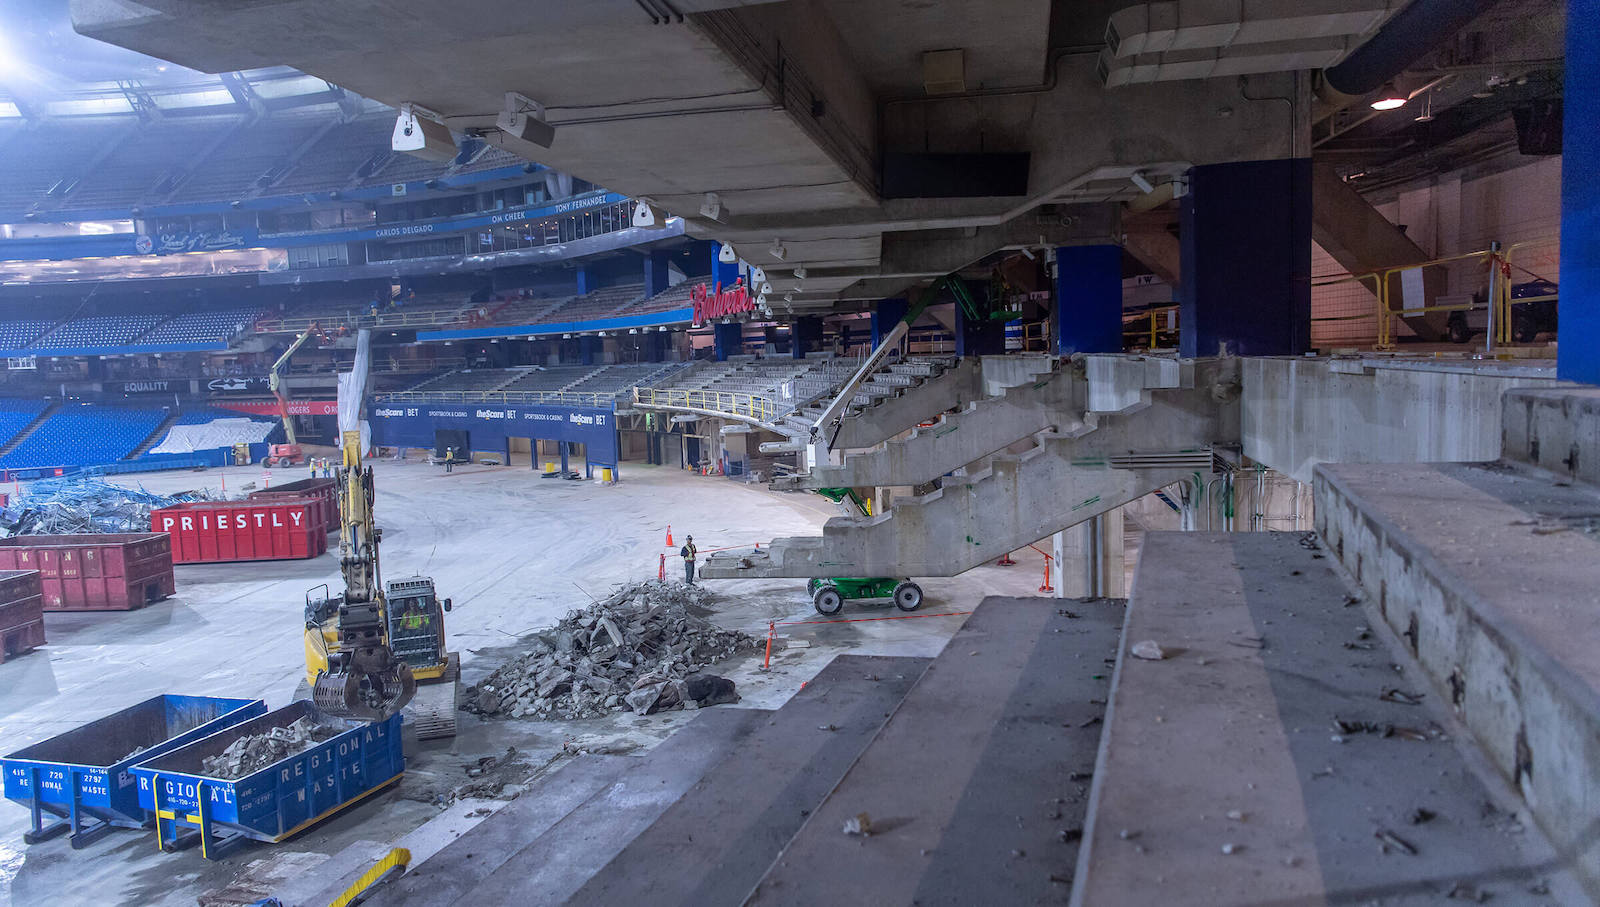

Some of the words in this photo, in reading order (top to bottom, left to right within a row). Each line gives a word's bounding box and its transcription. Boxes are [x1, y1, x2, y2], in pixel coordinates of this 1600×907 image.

[555, 203, 570, 213] TONY
[572, 195, 606, 209] FERNANDEZ
[504, 211, 526, 221] CHEEK
[376, 227, 400, 237] CARLOS
[402, 224, 433, 234] DELGADO
[124, 381, 169, 392] EQUALITY
[375, 408, 404, 419] theScore
[407, 408, 418, 417] BET
[476, 409, 505, 420] theScore
[507, 409, 516, 420] BET
[569, 412, 593, 425] theScore
[595, 414, 606, 426] BET
[163, 511, 303, 532] PRIESTLY
[281, 725, 385, 784] REGIONAL
[297, 761, 360, 802] WASTE
[82, 785, 107, 796] WASTE
